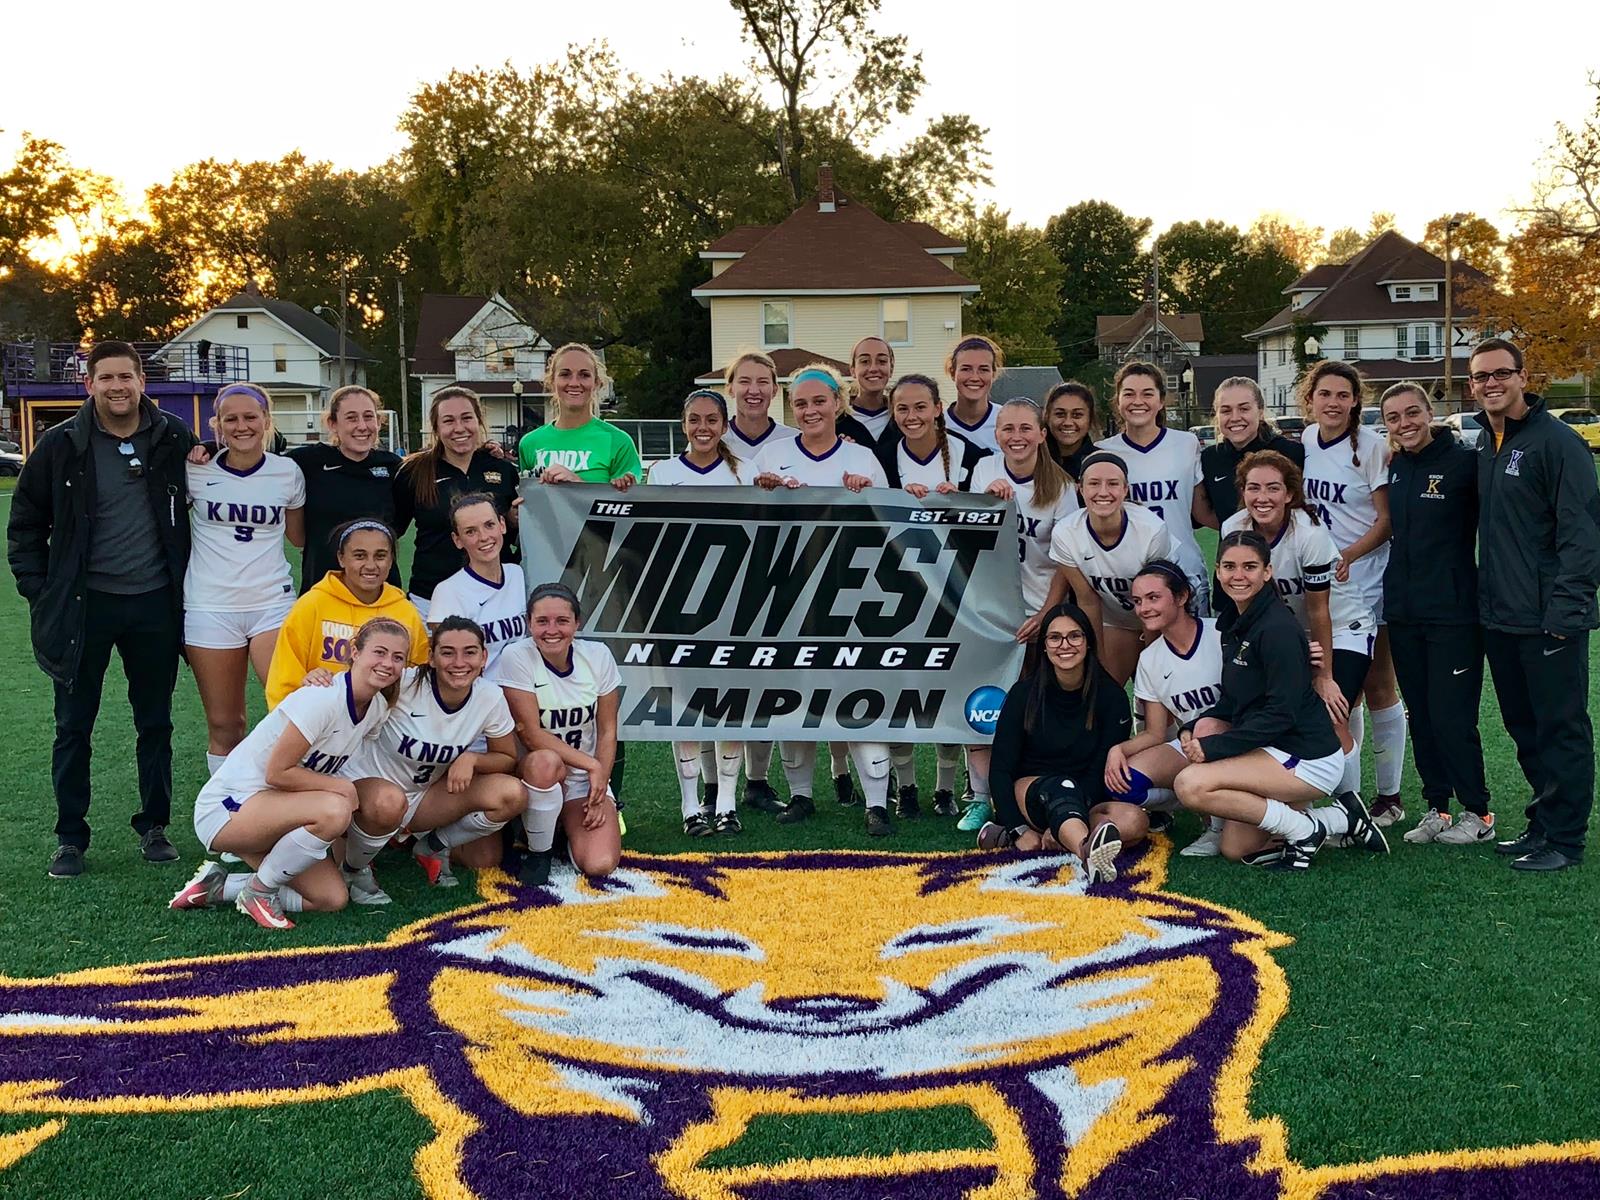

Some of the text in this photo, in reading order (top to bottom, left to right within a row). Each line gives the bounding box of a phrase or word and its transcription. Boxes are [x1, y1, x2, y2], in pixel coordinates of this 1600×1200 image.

[535, 448, 592, 473] KNOX
[1125, 480, 1179, 502] NOX
[1303, 477, 1348, 504] NOX
[1426, 479, 1441, 494] K
[206, 500, 283, 525] KNOX
[596, 503, 633, 515] THE
[909, 510, 1001, 524] EST. 1921
[233, 525, 255, 543] 9
[559, 519, 1000, 638] MIDWEST
[624, 643, 950, 668] NFERENCE
[617, 685, 947, 729] AMPION
[969, 708, 1001, 723] NCA
[303, 749, 350, 775] KNO
[413, 765, 436, 784] 3
